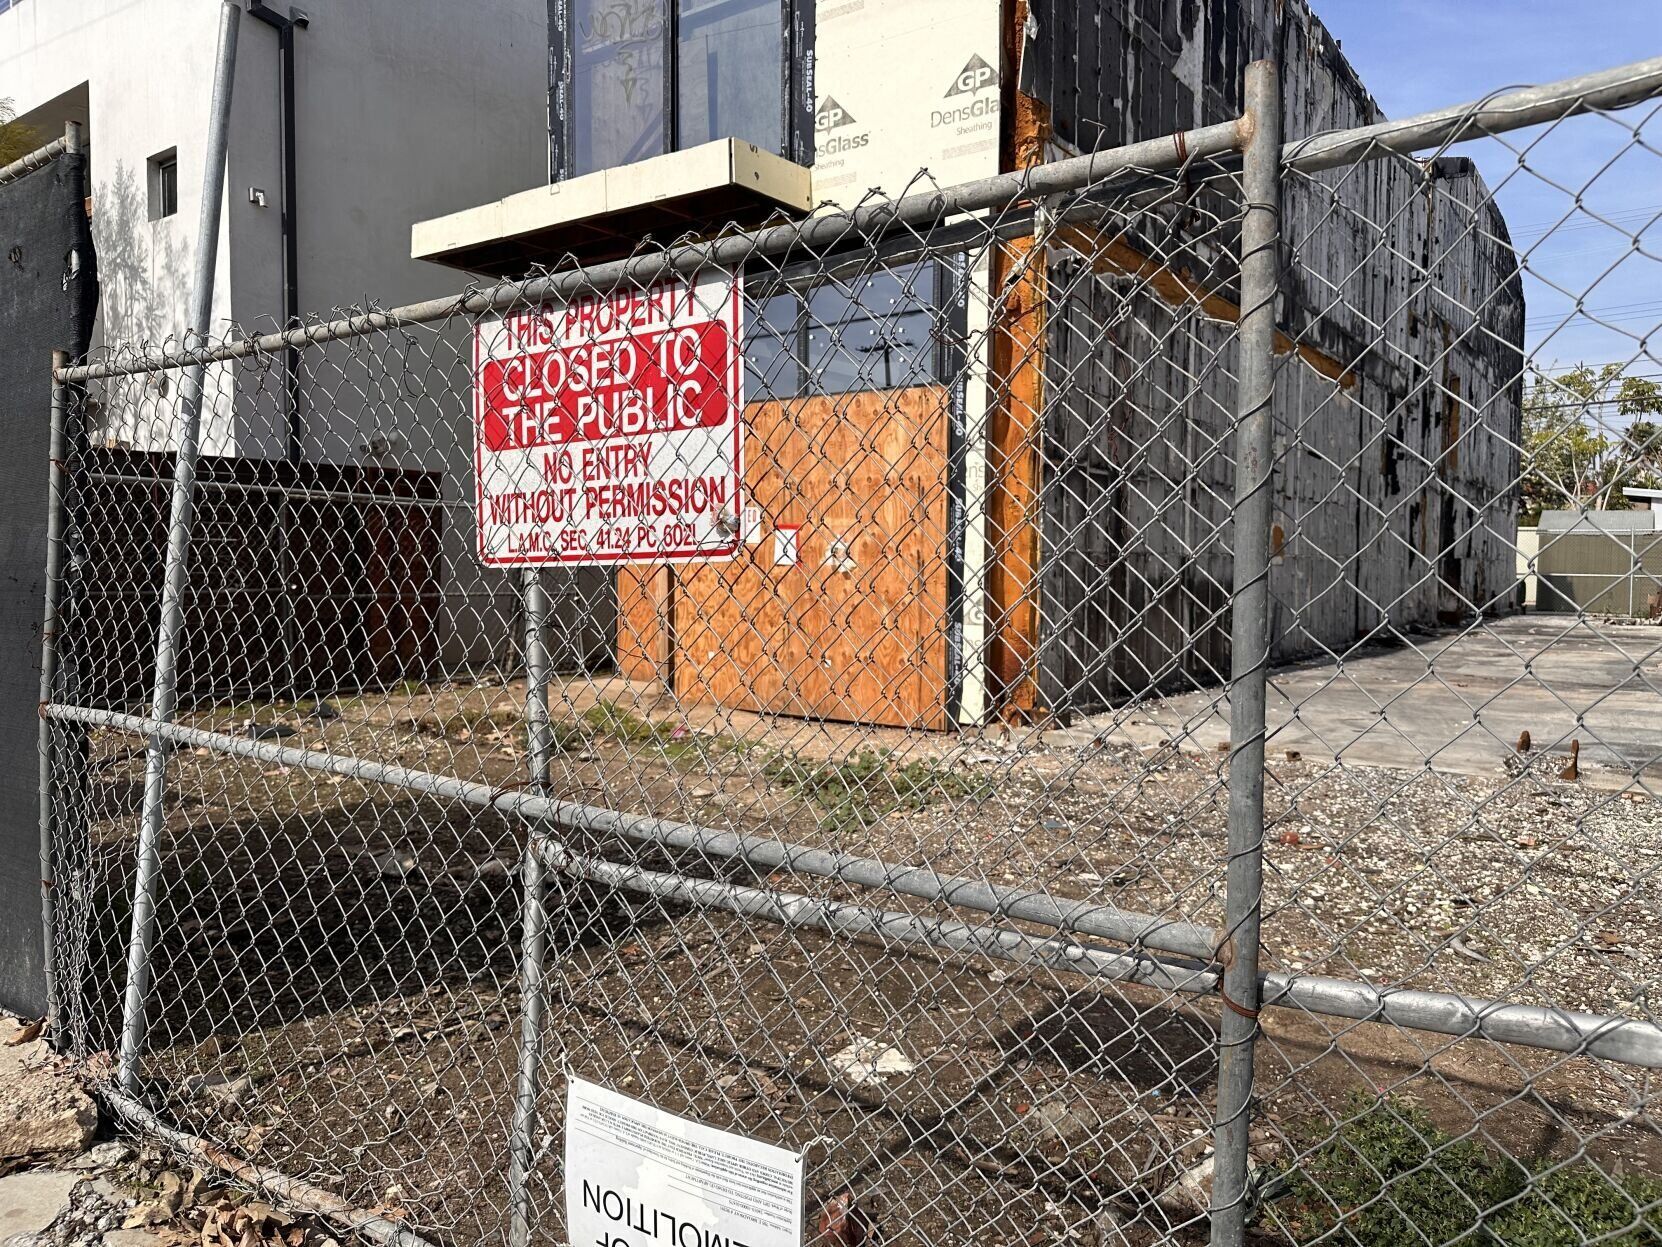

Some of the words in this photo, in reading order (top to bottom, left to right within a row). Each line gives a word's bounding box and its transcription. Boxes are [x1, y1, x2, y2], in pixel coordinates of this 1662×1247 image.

[957, 66, 991, 91] GP
[815, 108, 843, 130] GP
[956, 121, 993, 136] Sheathing
[506, 304, 555, 351] THIS
[566, 274, 699, 338] PROPERTY
[502, 339, 637, 402] CLOSED
[501, 403, 563, 448] THE
[577, 378, 704, 438] PUBLIC
[543, 450, 573, 485] NO
[582, 442, 653, 482] ENTRY
[489, 488, 577, 525] WITHOUT
[585, 475, 726, 520] PERMISSION
[596, 526, 631, 549] 41.24
[637, 526, 657, 548] PC
